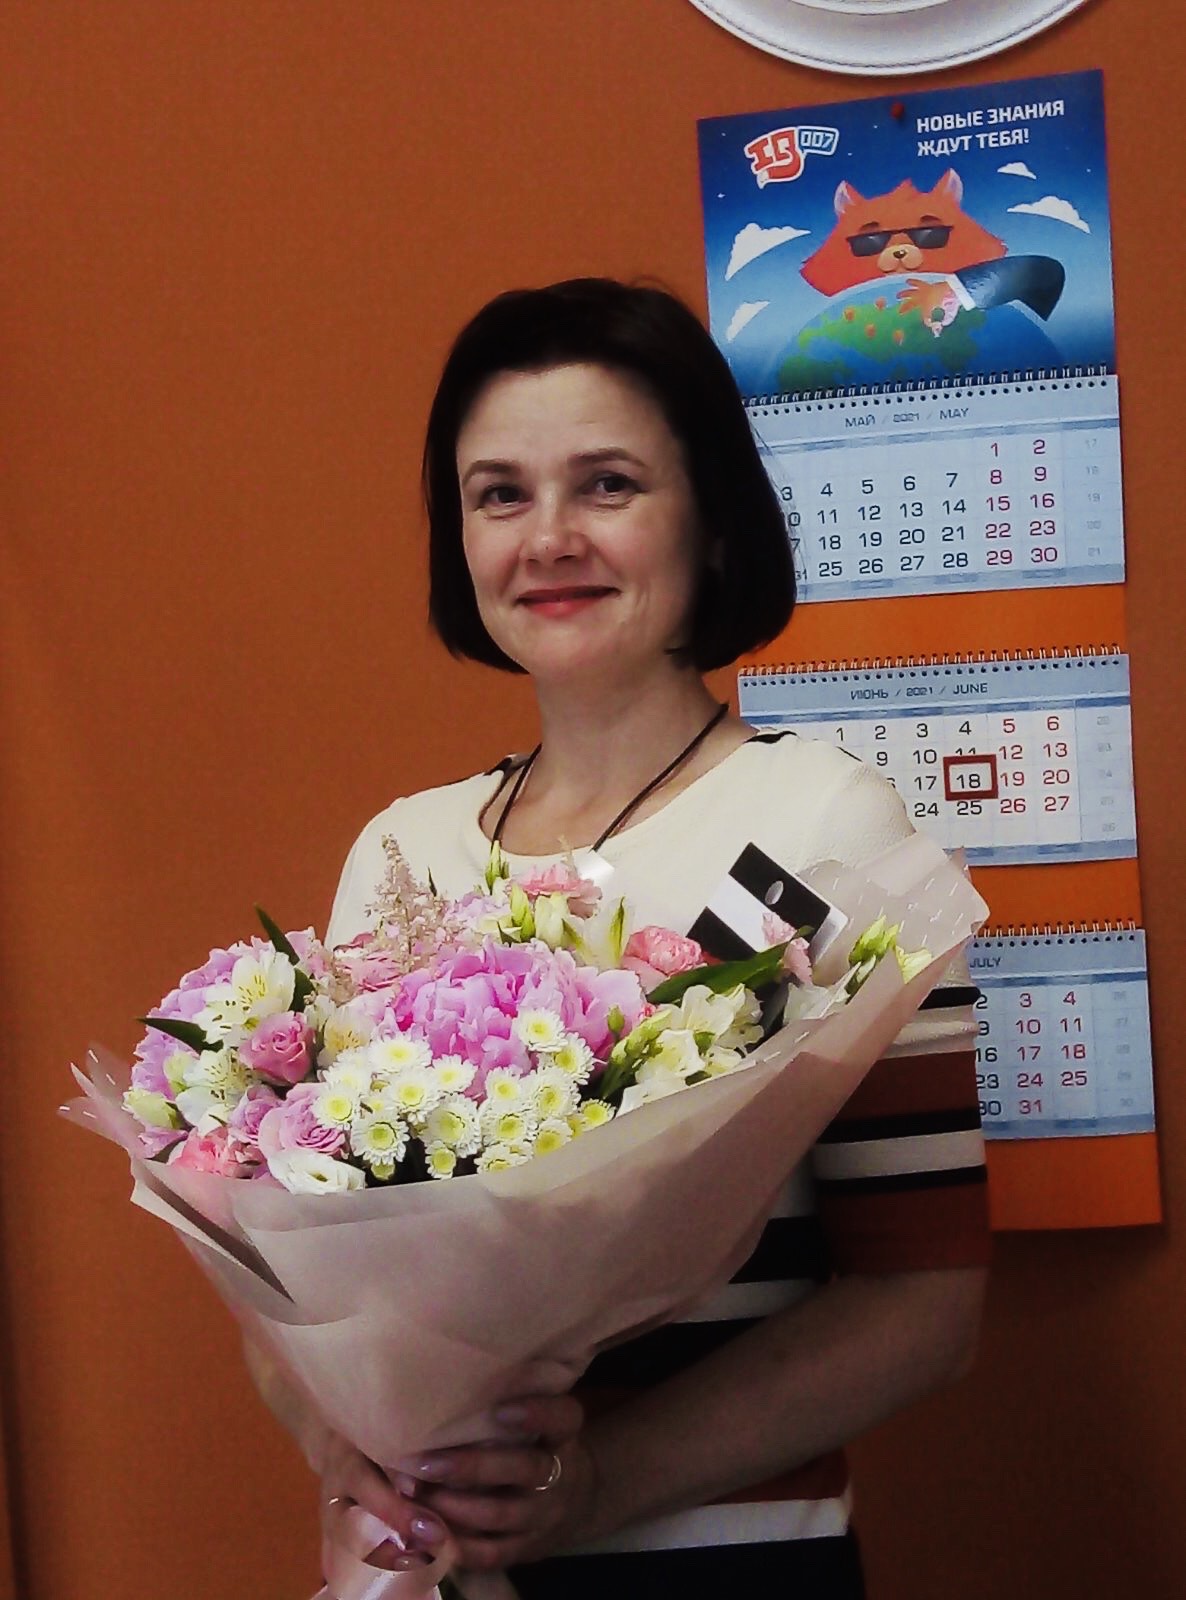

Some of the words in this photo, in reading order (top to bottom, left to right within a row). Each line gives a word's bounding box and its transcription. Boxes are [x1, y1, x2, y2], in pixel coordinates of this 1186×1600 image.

[917, 110, 984, 133] НОВЫЕ
[987, 100, 1065, 125] ЗНАНИЯ
[800, 131, 835, 148] 007
[917, 135, 972, 157] ЖДУТ
[975, 128, 1029, 149] ТЕБЯ!
[940, 407, 969, 420] MAY
[991, 443, 998, 457] 1
[1033, 439, 1045, 454] 2
[780, 486, 793, 501] 3
[821, 483, 833, 496] 4
[862, 479, 873, 494] 5
[904, 476, 915, 490] 6
[946, 473, 957, 487] 7
[991, 470, 1002, 484] 8
[1035, 467, 1046, 481] 9
[788, 512, 801, 527] 0
[817, 510, 839, 524] 11
[858, 505, 880, 520] 12
[900, 502, 923, 518] 13
[943, 499, 966, 515] 14
[987, 496, 1010, 511] 15
[1030, 493, 1054, 508] 16
[788, 538, 801, 552] 7
[819, 535, 841, 550] 18
[859, 532, 882, 547] 19
[899, 529, 925, 544] 20
[942, 526, 964, 541] 21
[986, 523, 1011, 538] 22
[1030, 520, 1055, 536] 23
[819, 561, 842, 577] 25
[859, 558, 883, 574] 26
[901, 556, 924, 571] 27
[943, 553, 968, 568] 28
[987, 550, 1012, 565] 29
[1031, 547, 1057, 563] 30
[906, 687, 933, 697] 2021
[953, 683, 988, 694] JUNE
[837, 728, 843, 741] 1
[875, 725, 886, 739] 2
[917, 723, 928, 737] 3
[959, 721, 971, 735] 4
[1003, 719, 1015, 733] 5
[1047, 716, 1059, 730] 6
[877, 752, 887, 766] 9
[913, 749, 937, 764] 10
[999, 745, 1022, 759] 12
[1043, 743, 1067, 757] 13
[915, 776, 936, 790] 17
[957, 774, 981, 789] 18
[1000, 771, 1024, 786] 19
[1043, 769, 1069, 784] 20
[915, 803, 939, 817] 24
[957, 801, 983, 815] 25
[1000, 798, 1025, 813] 26
[1045, 796, 1069, 811] 27
[970, 957, 1001, 968] JULY
[976, 995, 988, 1009] 2
[1020, 993, 1031, 1007] 3
[1063, 992, 1076, 1005] 4
[1016, 1020, 1041, 1034] 10
[1060, 1018, 1081, 1032] 11
[976, 1048, 997, 1062] 16
[1018, 1046, 1041, 1061] 17
[1061, 1045, 1086, 1059] 18
[976, 1074, 999, 1088] 23
[1017, 1073, 1043, 1087] 24
[1061, 1071, 1087, 1086] 25
[1019, 1100, 1042, 1114] 31
